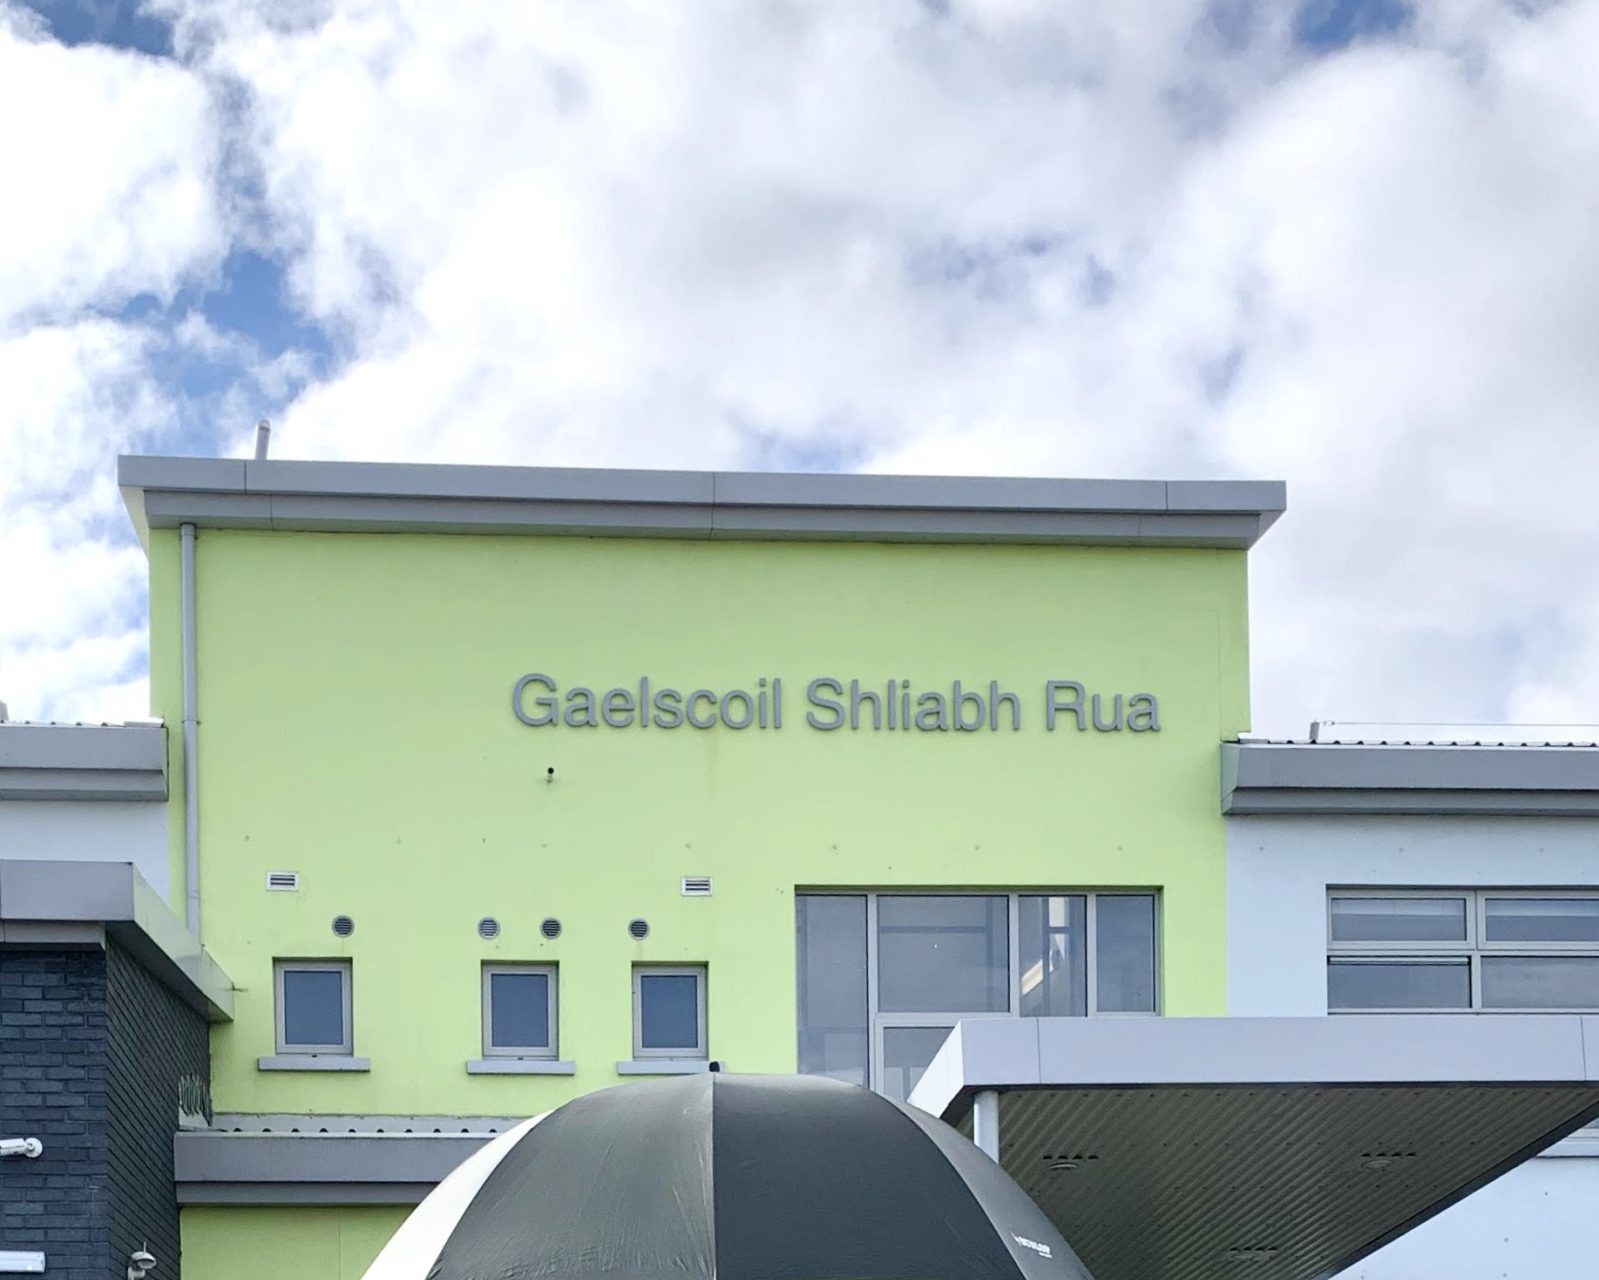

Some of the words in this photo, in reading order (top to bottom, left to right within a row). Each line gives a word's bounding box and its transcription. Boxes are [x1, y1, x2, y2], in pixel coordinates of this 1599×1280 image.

[511, 672, 783, 730] Gaelscoil
[805, 675, 1022, 732] Shliabh
[1044, 678, 1161, 732] Rua
